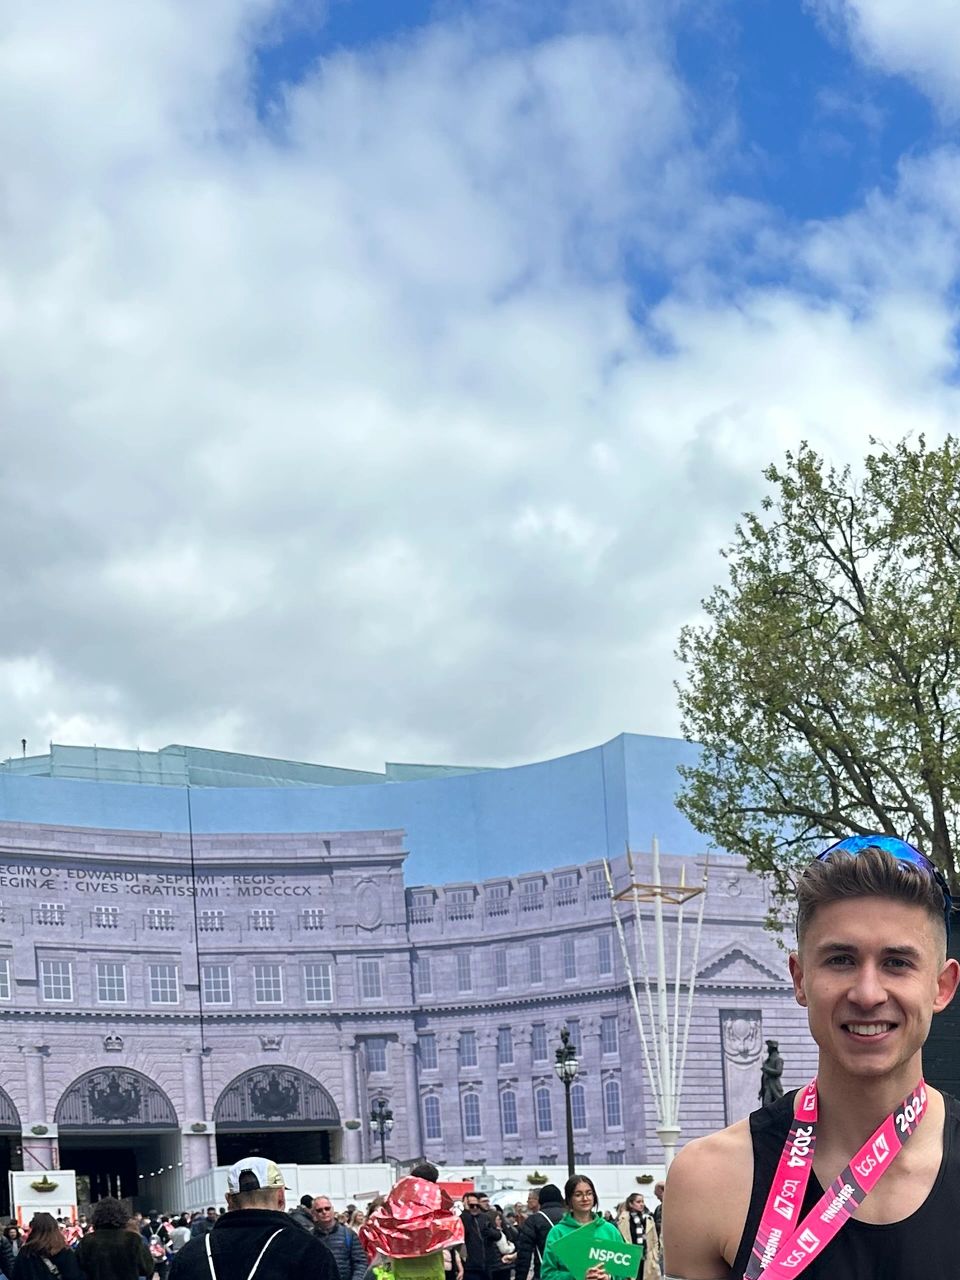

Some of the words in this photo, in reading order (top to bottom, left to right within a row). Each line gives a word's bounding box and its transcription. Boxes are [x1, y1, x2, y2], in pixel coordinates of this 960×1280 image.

[67, 869, 139, 882] EDWARDI
[156, 874, 214, 885] SEPTMI
[233, 875, 275, 885] REGIS
[75, 881, 119, 894] CIVES
[237, 886, 312, 897] MDCCCCX
[895, 1086, 927, 1132] 2024
[787, 1125, 813, 1168] 2024
[854, 1155, 878, 1177] tcs
[781, 1179, 802, 1198] tcs
[819, 1184, 856, 1223] FINISHER
[589, 1247, 632, 1267] NSPCC
[779, 1249, 807, 1268] tcs
